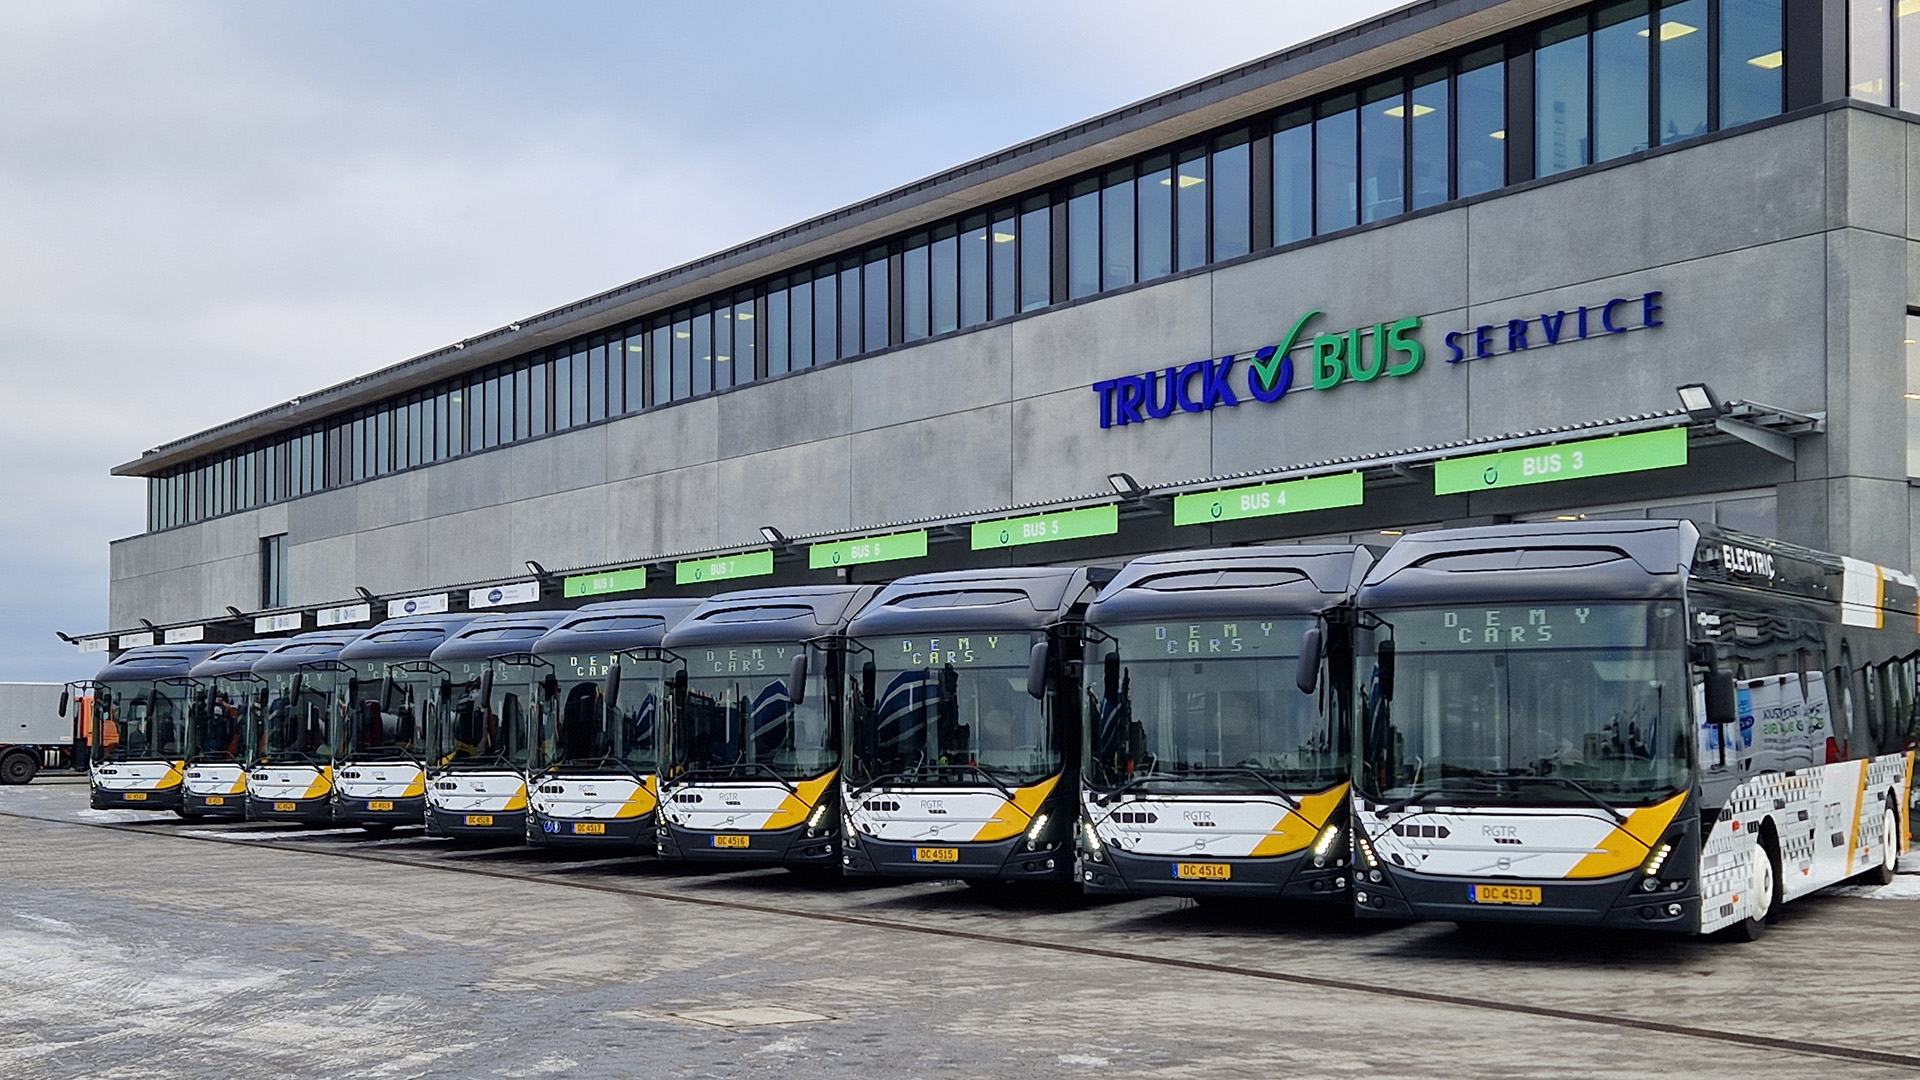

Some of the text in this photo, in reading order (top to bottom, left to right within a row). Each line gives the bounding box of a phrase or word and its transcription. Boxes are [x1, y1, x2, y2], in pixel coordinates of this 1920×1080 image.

[1093, 291, 1664, 429] TRUCK BUS SERVICE
[1523, 451, 1584, 476] BUS 3
[1240, 490, 1286, 511] BUS 4
[1023, 519, 1059, 538] BUS 5
[851, 543, 881, 559] BUS 6
[1722, 544, 1776, 579] ELECTRIC
[710, 562, 736, 576] BUS 7
[593, 578, 608, 590] BUS
[1458, 625, 1552, 643] CARS
[1166, 638, 1242, 653] CARS
[912, 650, 974, 665] CARS
[577, 665, 613, 677] CAR
[714, 660, 765, 673] CARS
[719, 792, 738, 801] RGTR
[920, 800, 944, 809] RGTR
[1183, 811, 1212, 821] RGTR
[1482, 825, 1517, 837] RGTR
[717, 837, 745, 845] DC 4516
[920, 850, 953, 859] DC 4515
[1183, 865, 1224, 876] DC 4514
[1483, 887, 1533, 901] DC 4513
